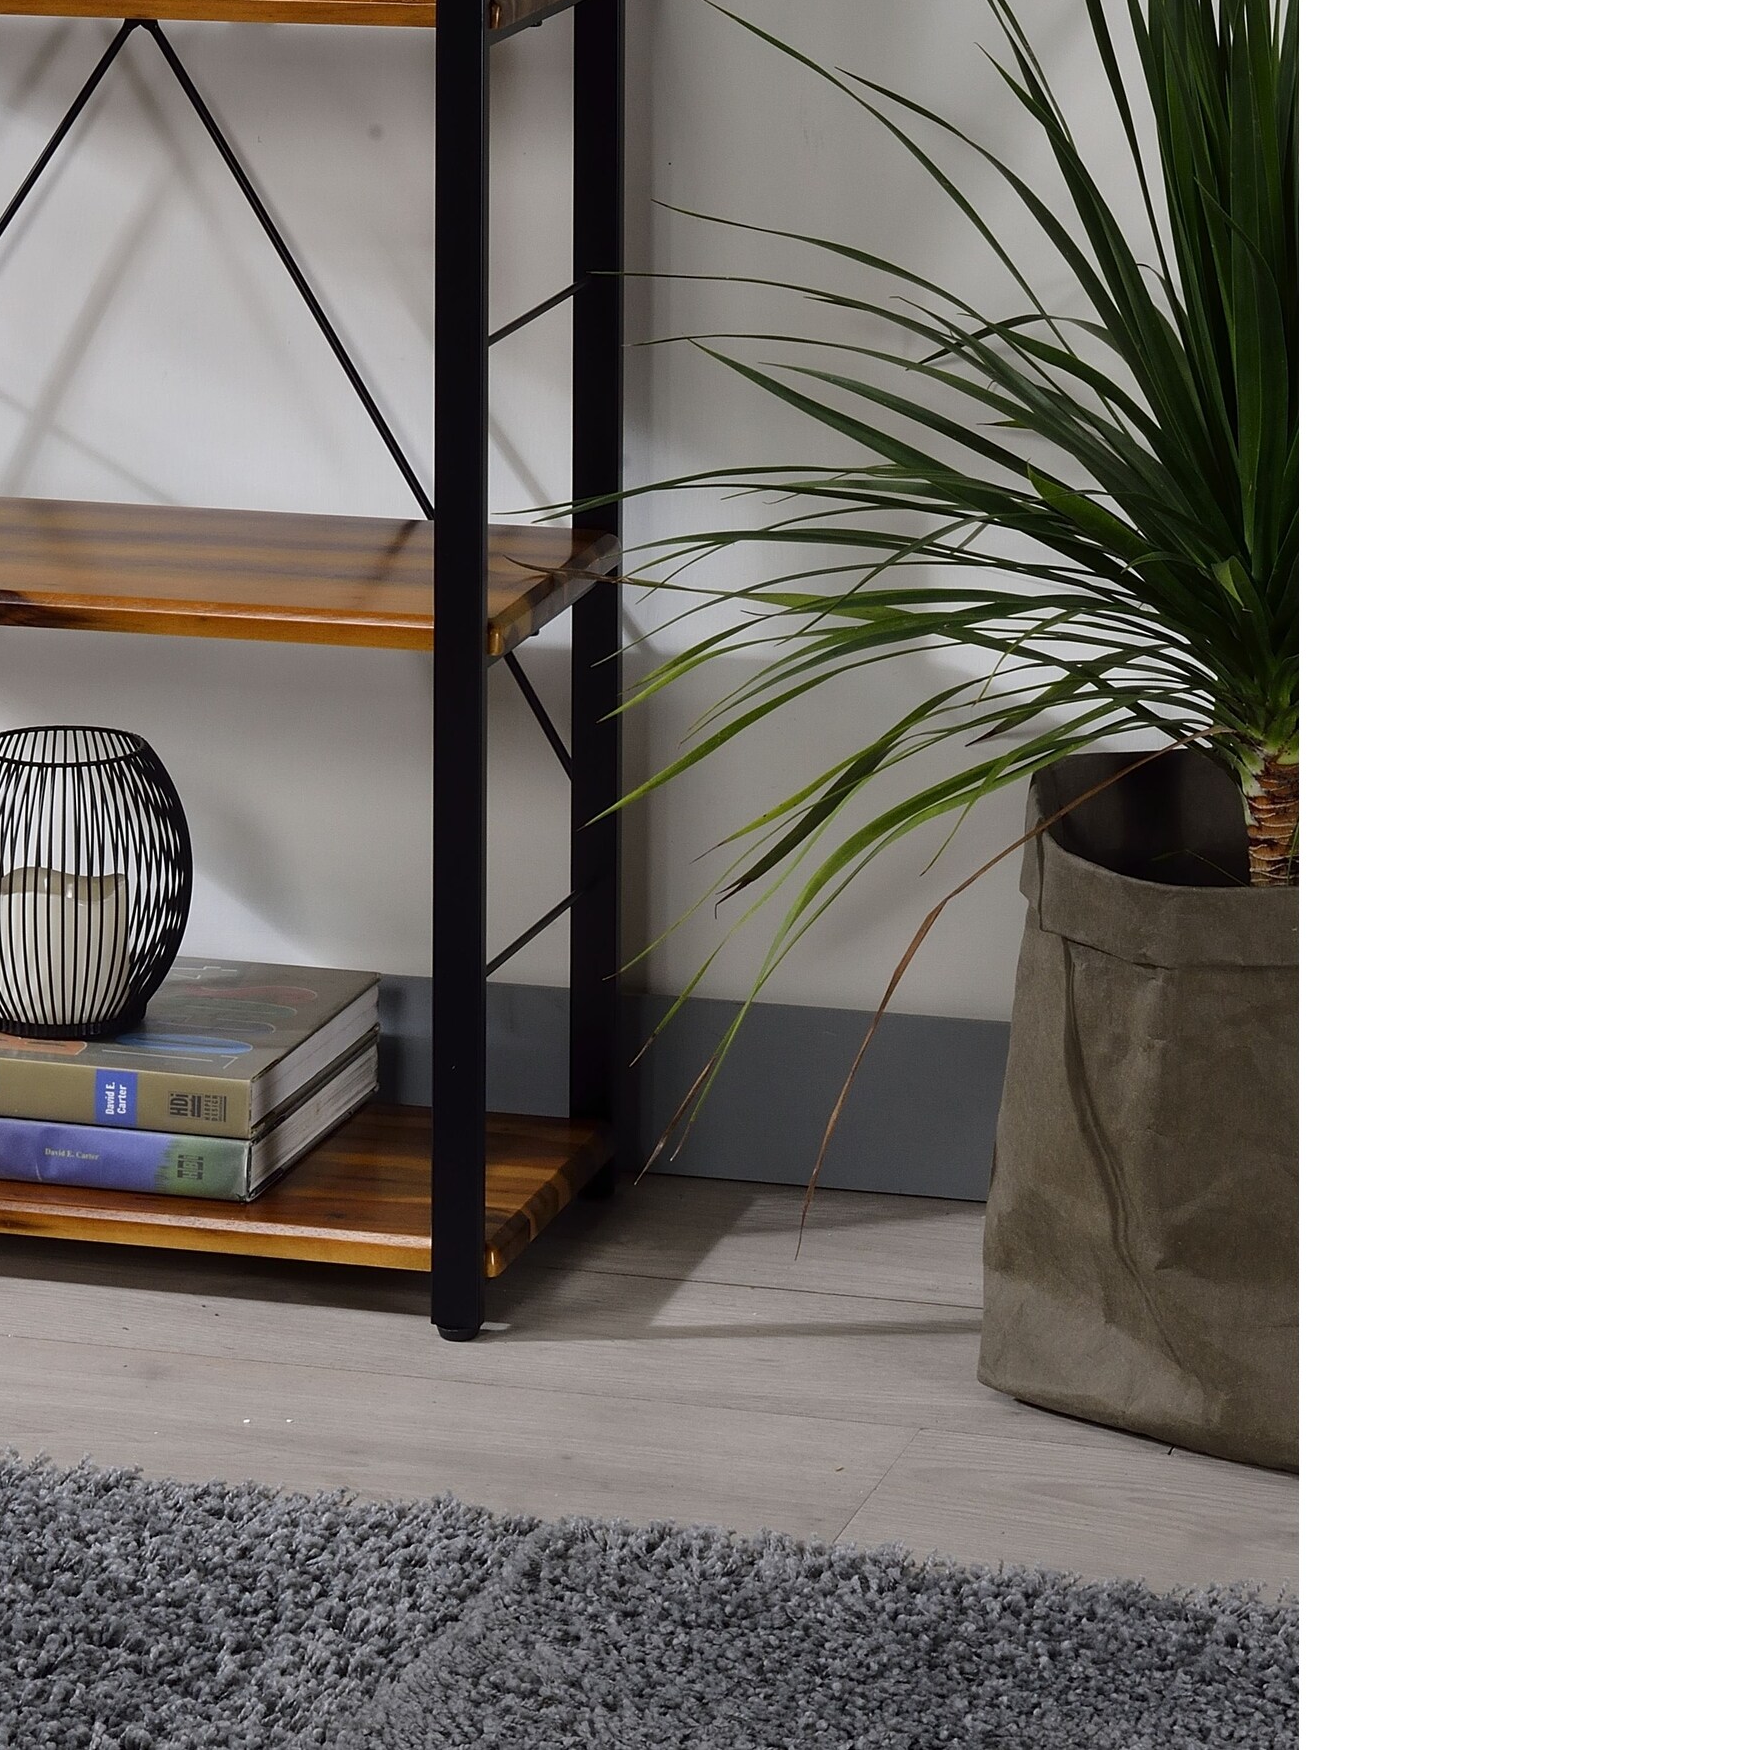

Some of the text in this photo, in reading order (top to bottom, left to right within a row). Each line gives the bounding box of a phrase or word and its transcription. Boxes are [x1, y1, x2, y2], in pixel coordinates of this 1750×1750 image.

[105, 1081, 115, 1115] David E.
[117, 1084, 127, 1114] Carter
[45, 1148, 66, 1157] David
[76, 1152, 100, 1160] Carter
